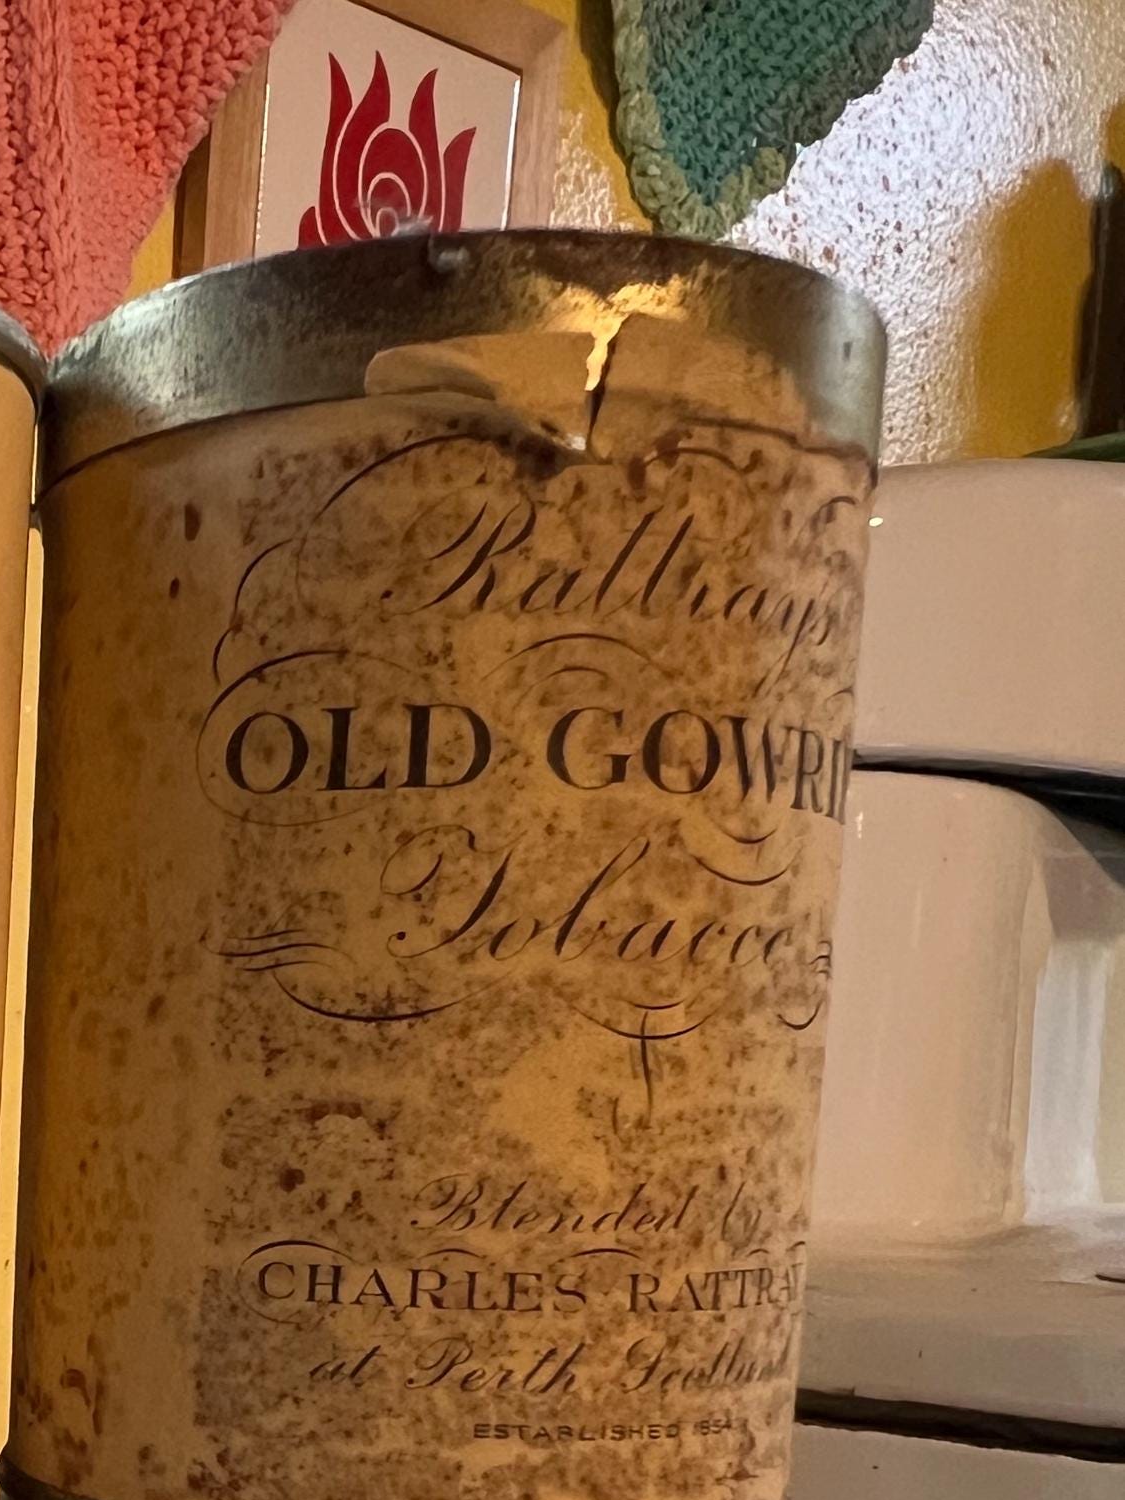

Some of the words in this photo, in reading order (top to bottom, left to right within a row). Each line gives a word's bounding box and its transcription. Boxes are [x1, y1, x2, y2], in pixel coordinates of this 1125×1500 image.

[224, 703, 492, 794] OLD
[410, 1173, 702, 1236] Blended
[258, 1261, 589, 1313] CHARLES
[309, 1343, 383, 1390] at
[473, 1421, 680, 1443] ESTABLISHED
